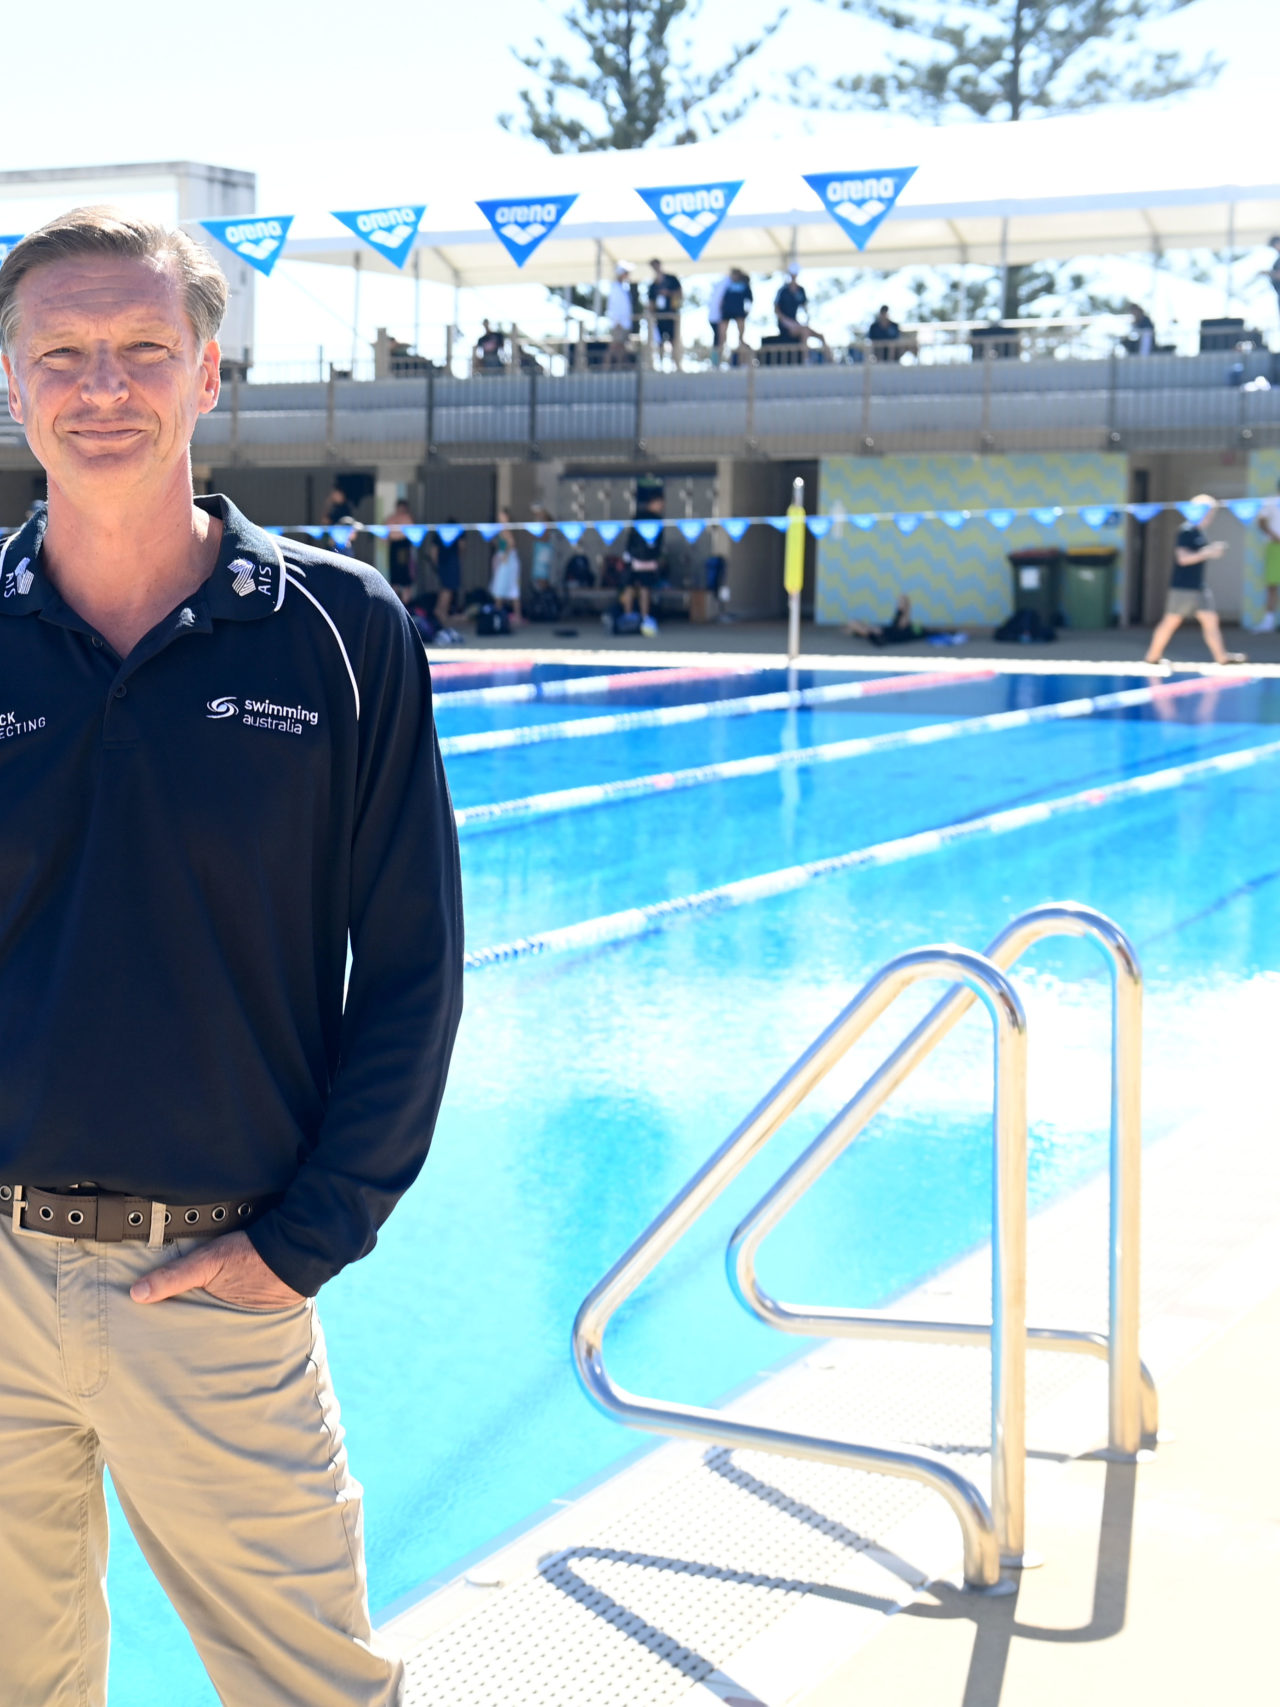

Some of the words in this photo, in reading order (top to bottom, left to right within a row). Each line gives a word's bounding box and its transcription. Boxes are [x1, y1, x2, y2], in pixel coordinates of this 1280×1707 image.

[661, 189, 725, 215] arena
[827, 177, 894, 202] arena
[358, 208, 416, 232] arena
[495, 204, 557, 223] arena
[225, 220, 280, 243] arena
[4, 572, 15, 599] AIS
[258, 565, 272, 596] AIS
[242, 714, 303, 735] australia
[244, 699, 319, 726] swimming
